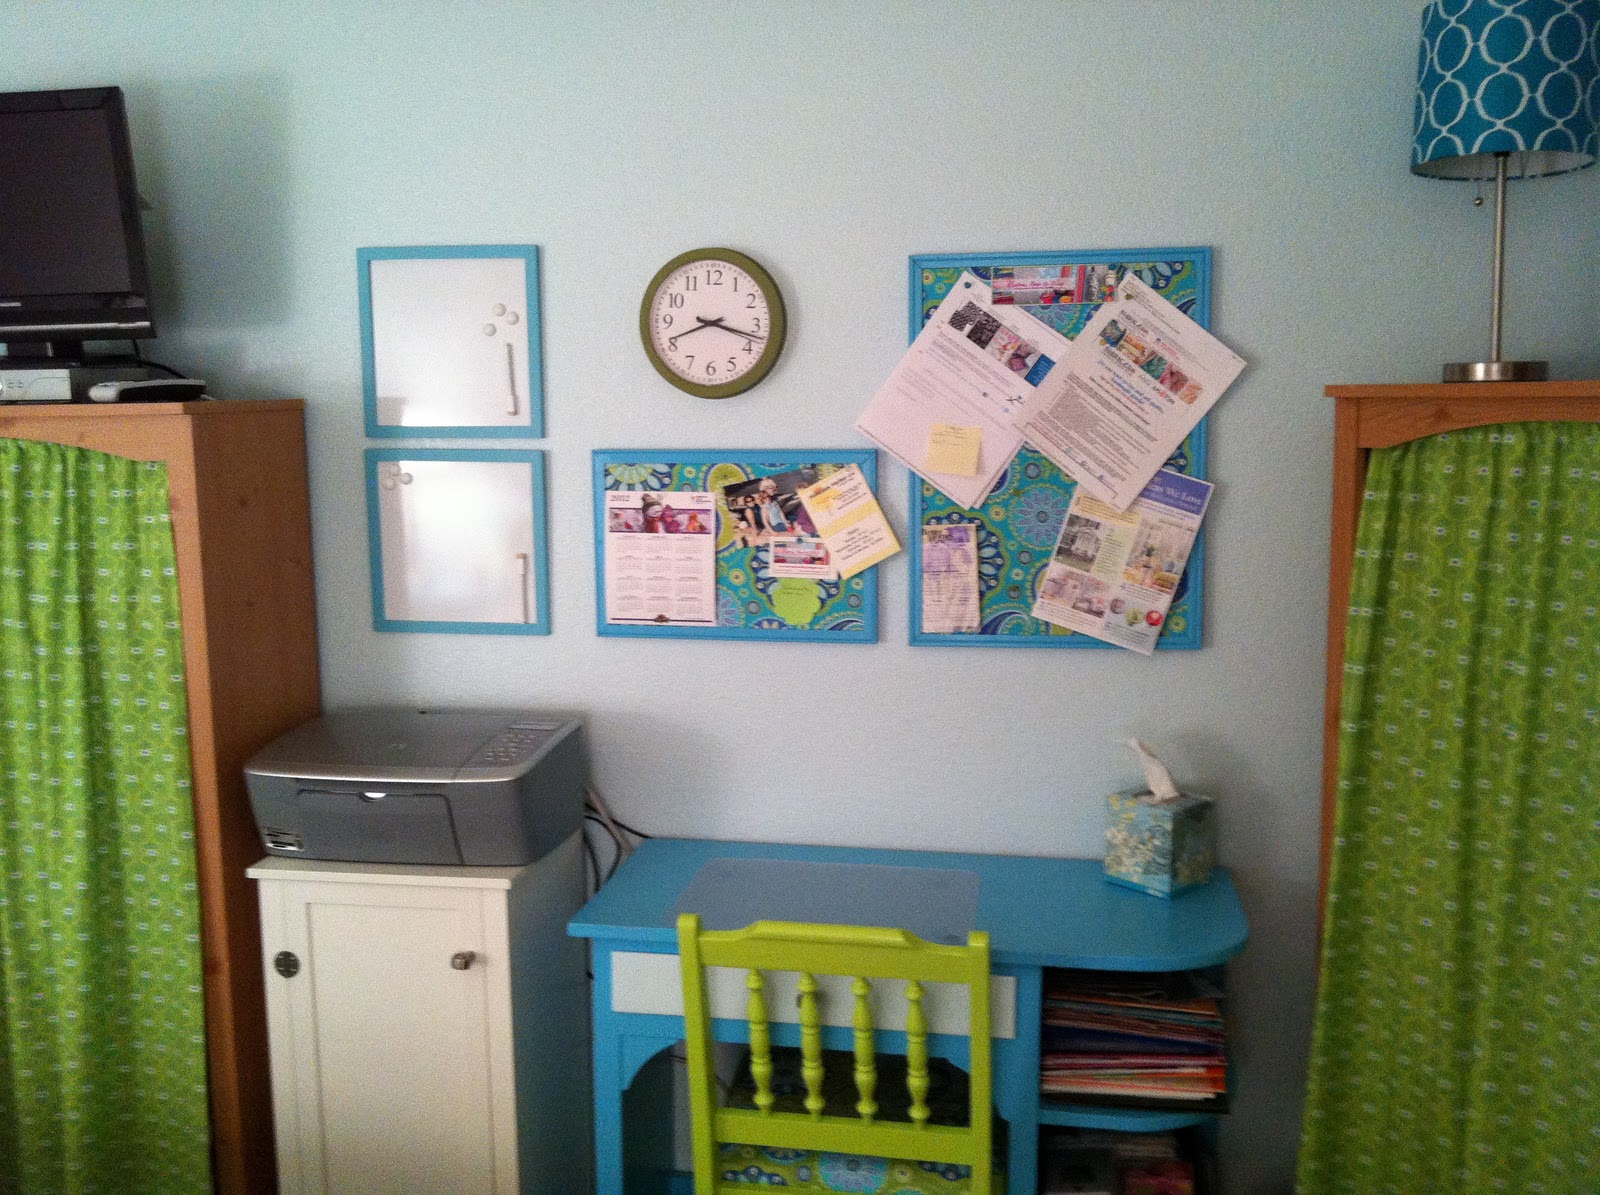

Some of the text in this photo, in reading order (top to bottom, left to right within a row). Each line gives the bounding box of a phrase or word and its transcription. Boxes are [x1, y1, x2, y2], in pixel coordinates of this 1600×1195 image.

[685, 276, 698, 291] 11
[706, 270, 723, 286] 12
[733, 277, 738, 292] 1
[668, 292, 684, 308] 10
[746, 293, 756, 309] 2
[663, 314, 673, 329] 9
[751, 317, 761, 333] 3
[668, 337, 678, 352] 8
[742, 340, 753, 355] 4
[686, 355, 695, 370] 7
[706, 361, 717, 376] 6
[727, 356, 737, 372] 5
